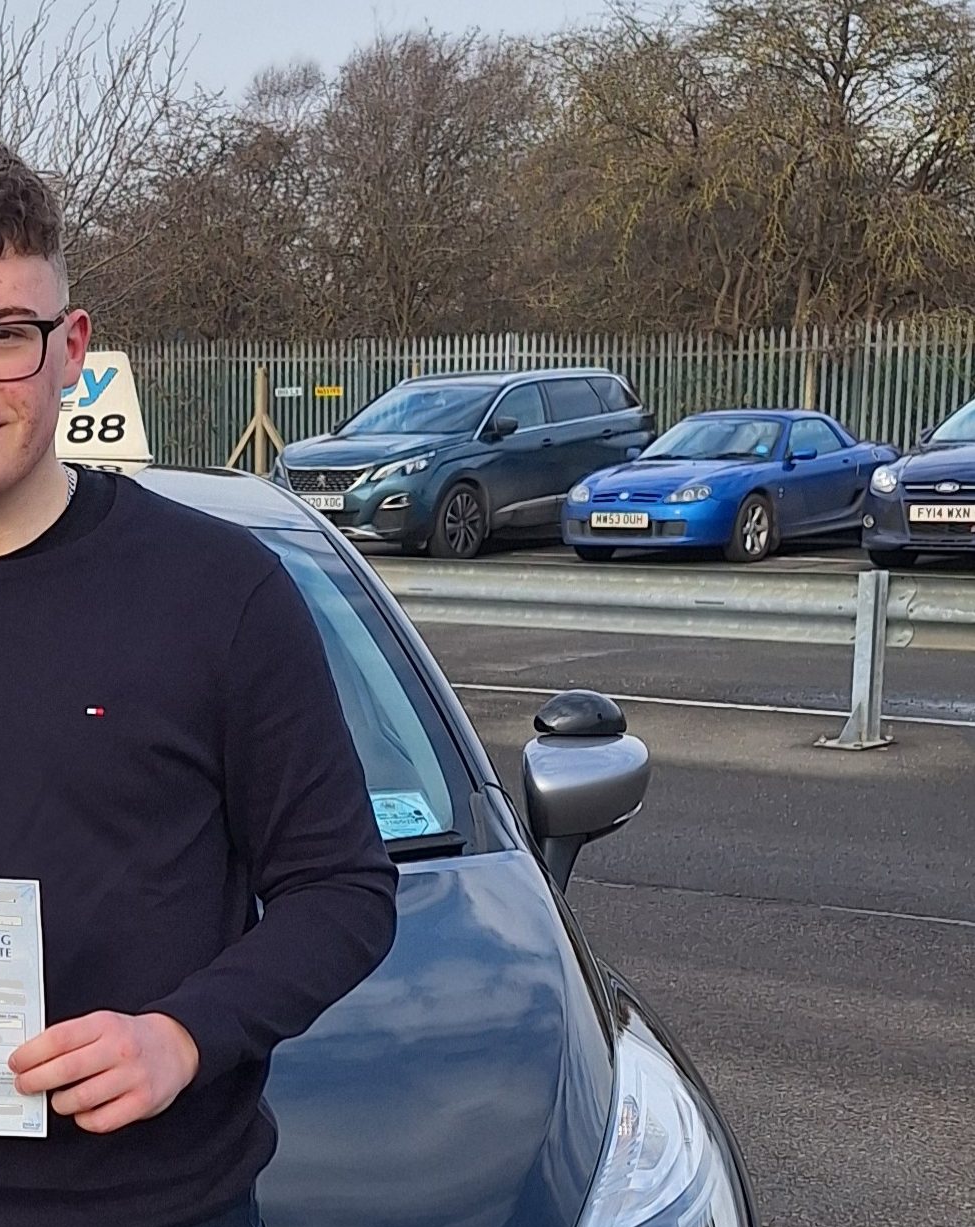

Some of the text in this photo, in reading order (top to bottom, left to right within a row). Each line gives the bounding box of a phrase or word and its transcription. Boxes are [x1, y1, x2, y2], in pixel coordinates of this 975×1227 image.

[67, 414, 126, 443] 88
[917, 507, 971, 519] FY14 WXN
